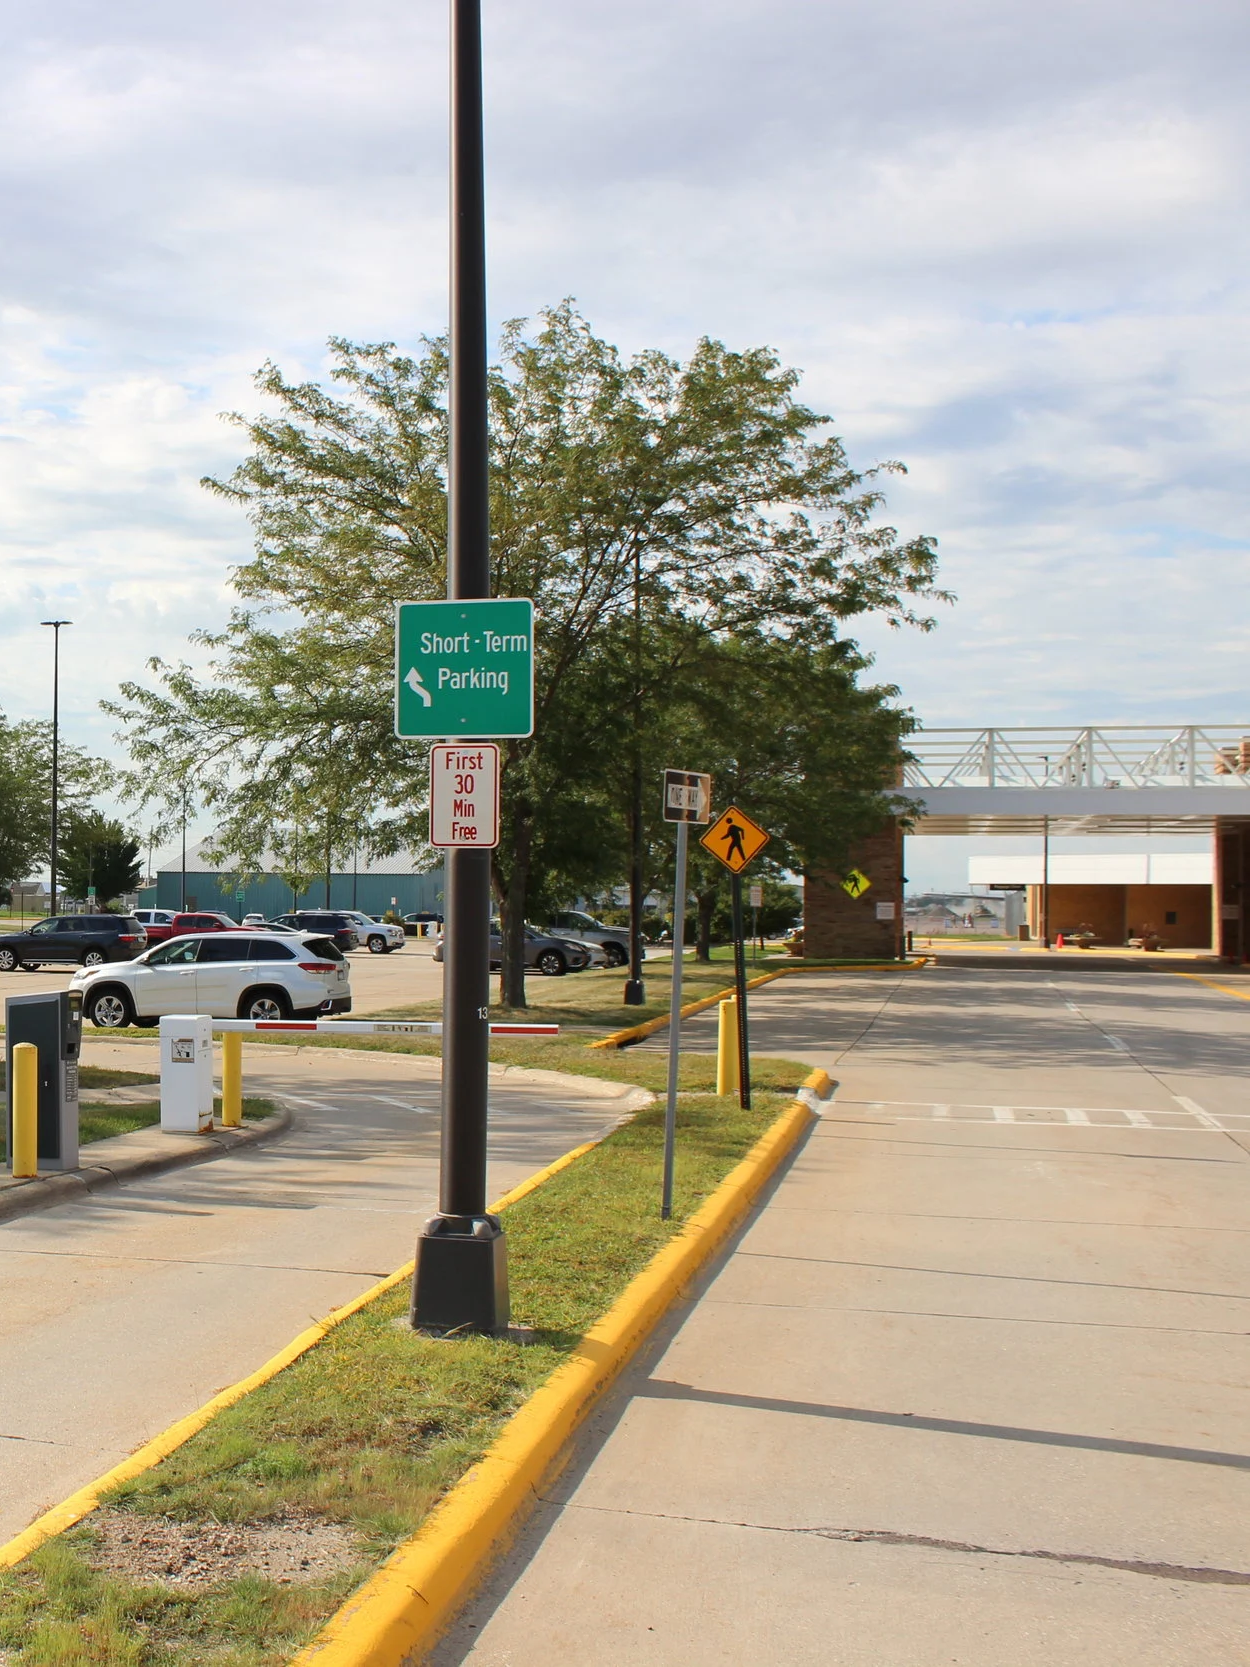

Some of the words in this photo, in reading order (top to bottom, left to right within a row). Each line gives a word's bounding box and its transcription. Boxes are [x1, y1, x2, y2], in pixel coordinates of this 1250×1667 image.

[420, 632, 469, 654] Short
[483, 631, 527, 653] Term
[438, 667, 509, 695] Parking
[445, 752, 484, 770] First
[454, 774, 474, 795] 30
[670, 787, 683, 806] ONE
[453, 799, 475, 818] Min
[452, 822, 477, 841] Free
[477, 1006, 488, 1020] 13
